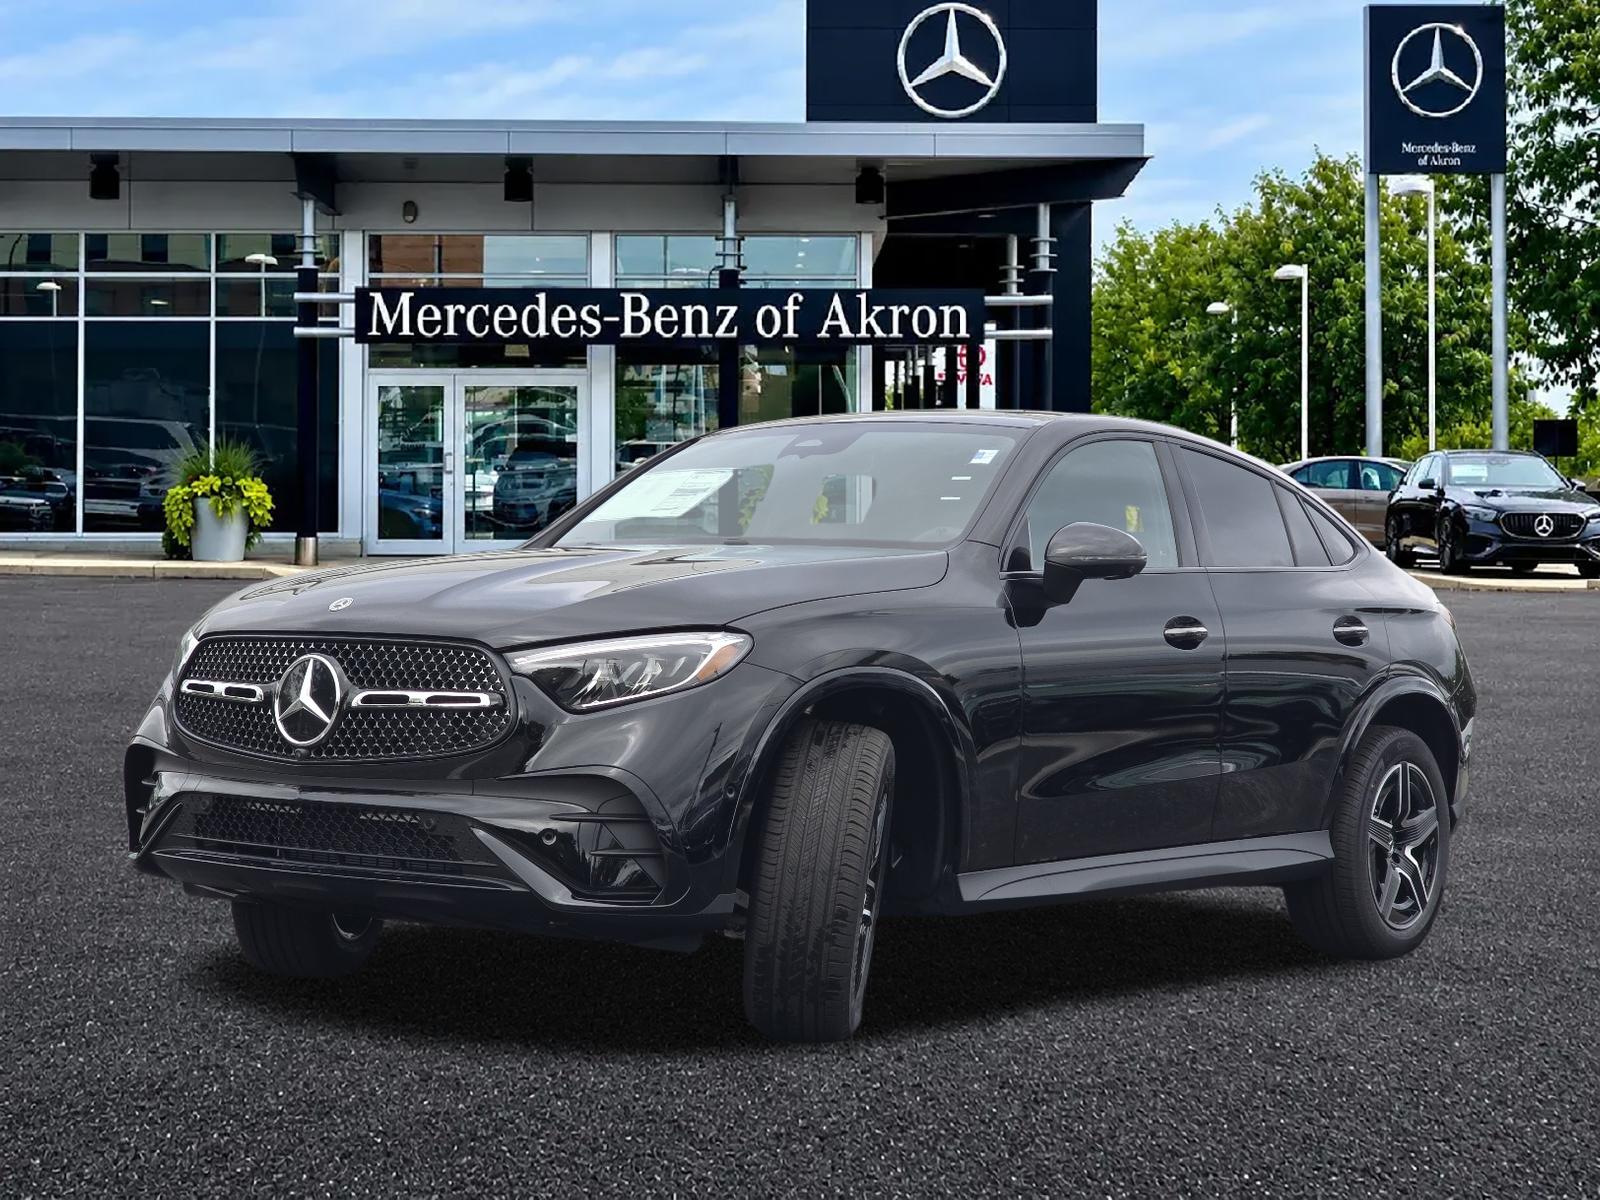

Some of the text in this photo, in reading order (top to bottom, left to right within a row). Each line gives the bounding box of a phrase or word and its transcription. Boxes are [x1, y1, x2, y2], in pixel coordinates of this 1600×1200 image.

[1401, 141, 1476, 153] Mercedes-Benz
[1417, 154, 1461, 166] of Akron
[367, 291, 971, 339] Mercedes-Benz of Akron
